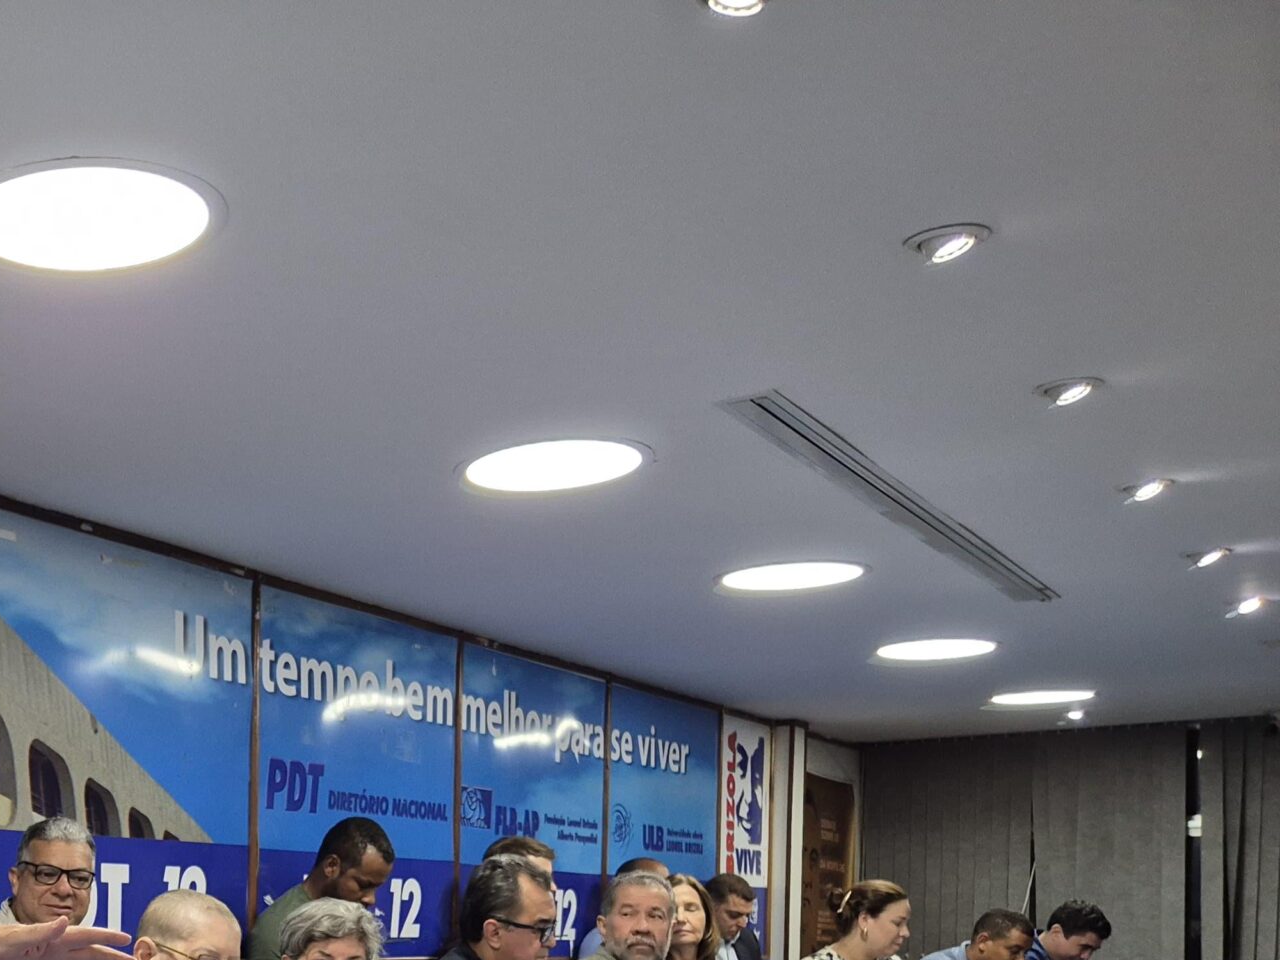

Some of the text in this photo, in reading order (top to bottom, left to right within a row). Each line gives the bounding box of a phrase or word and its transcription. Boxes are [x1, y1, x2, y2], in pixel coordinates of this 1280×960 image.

[174, 610, 690, 774] Um tempo bem melhor para se viver
[265, 758, 325, 814] PDT
[327, 789, 448, 822] DIRETÓRIO NACIONAL
[725, 730, 737, 875] BRIZOLA
[642, 824, 664, 852] ULB
[735, 848, 761, 876] VIVE
[390, 878, 421, 938] 12
[554, 888, 577, 940] 12
